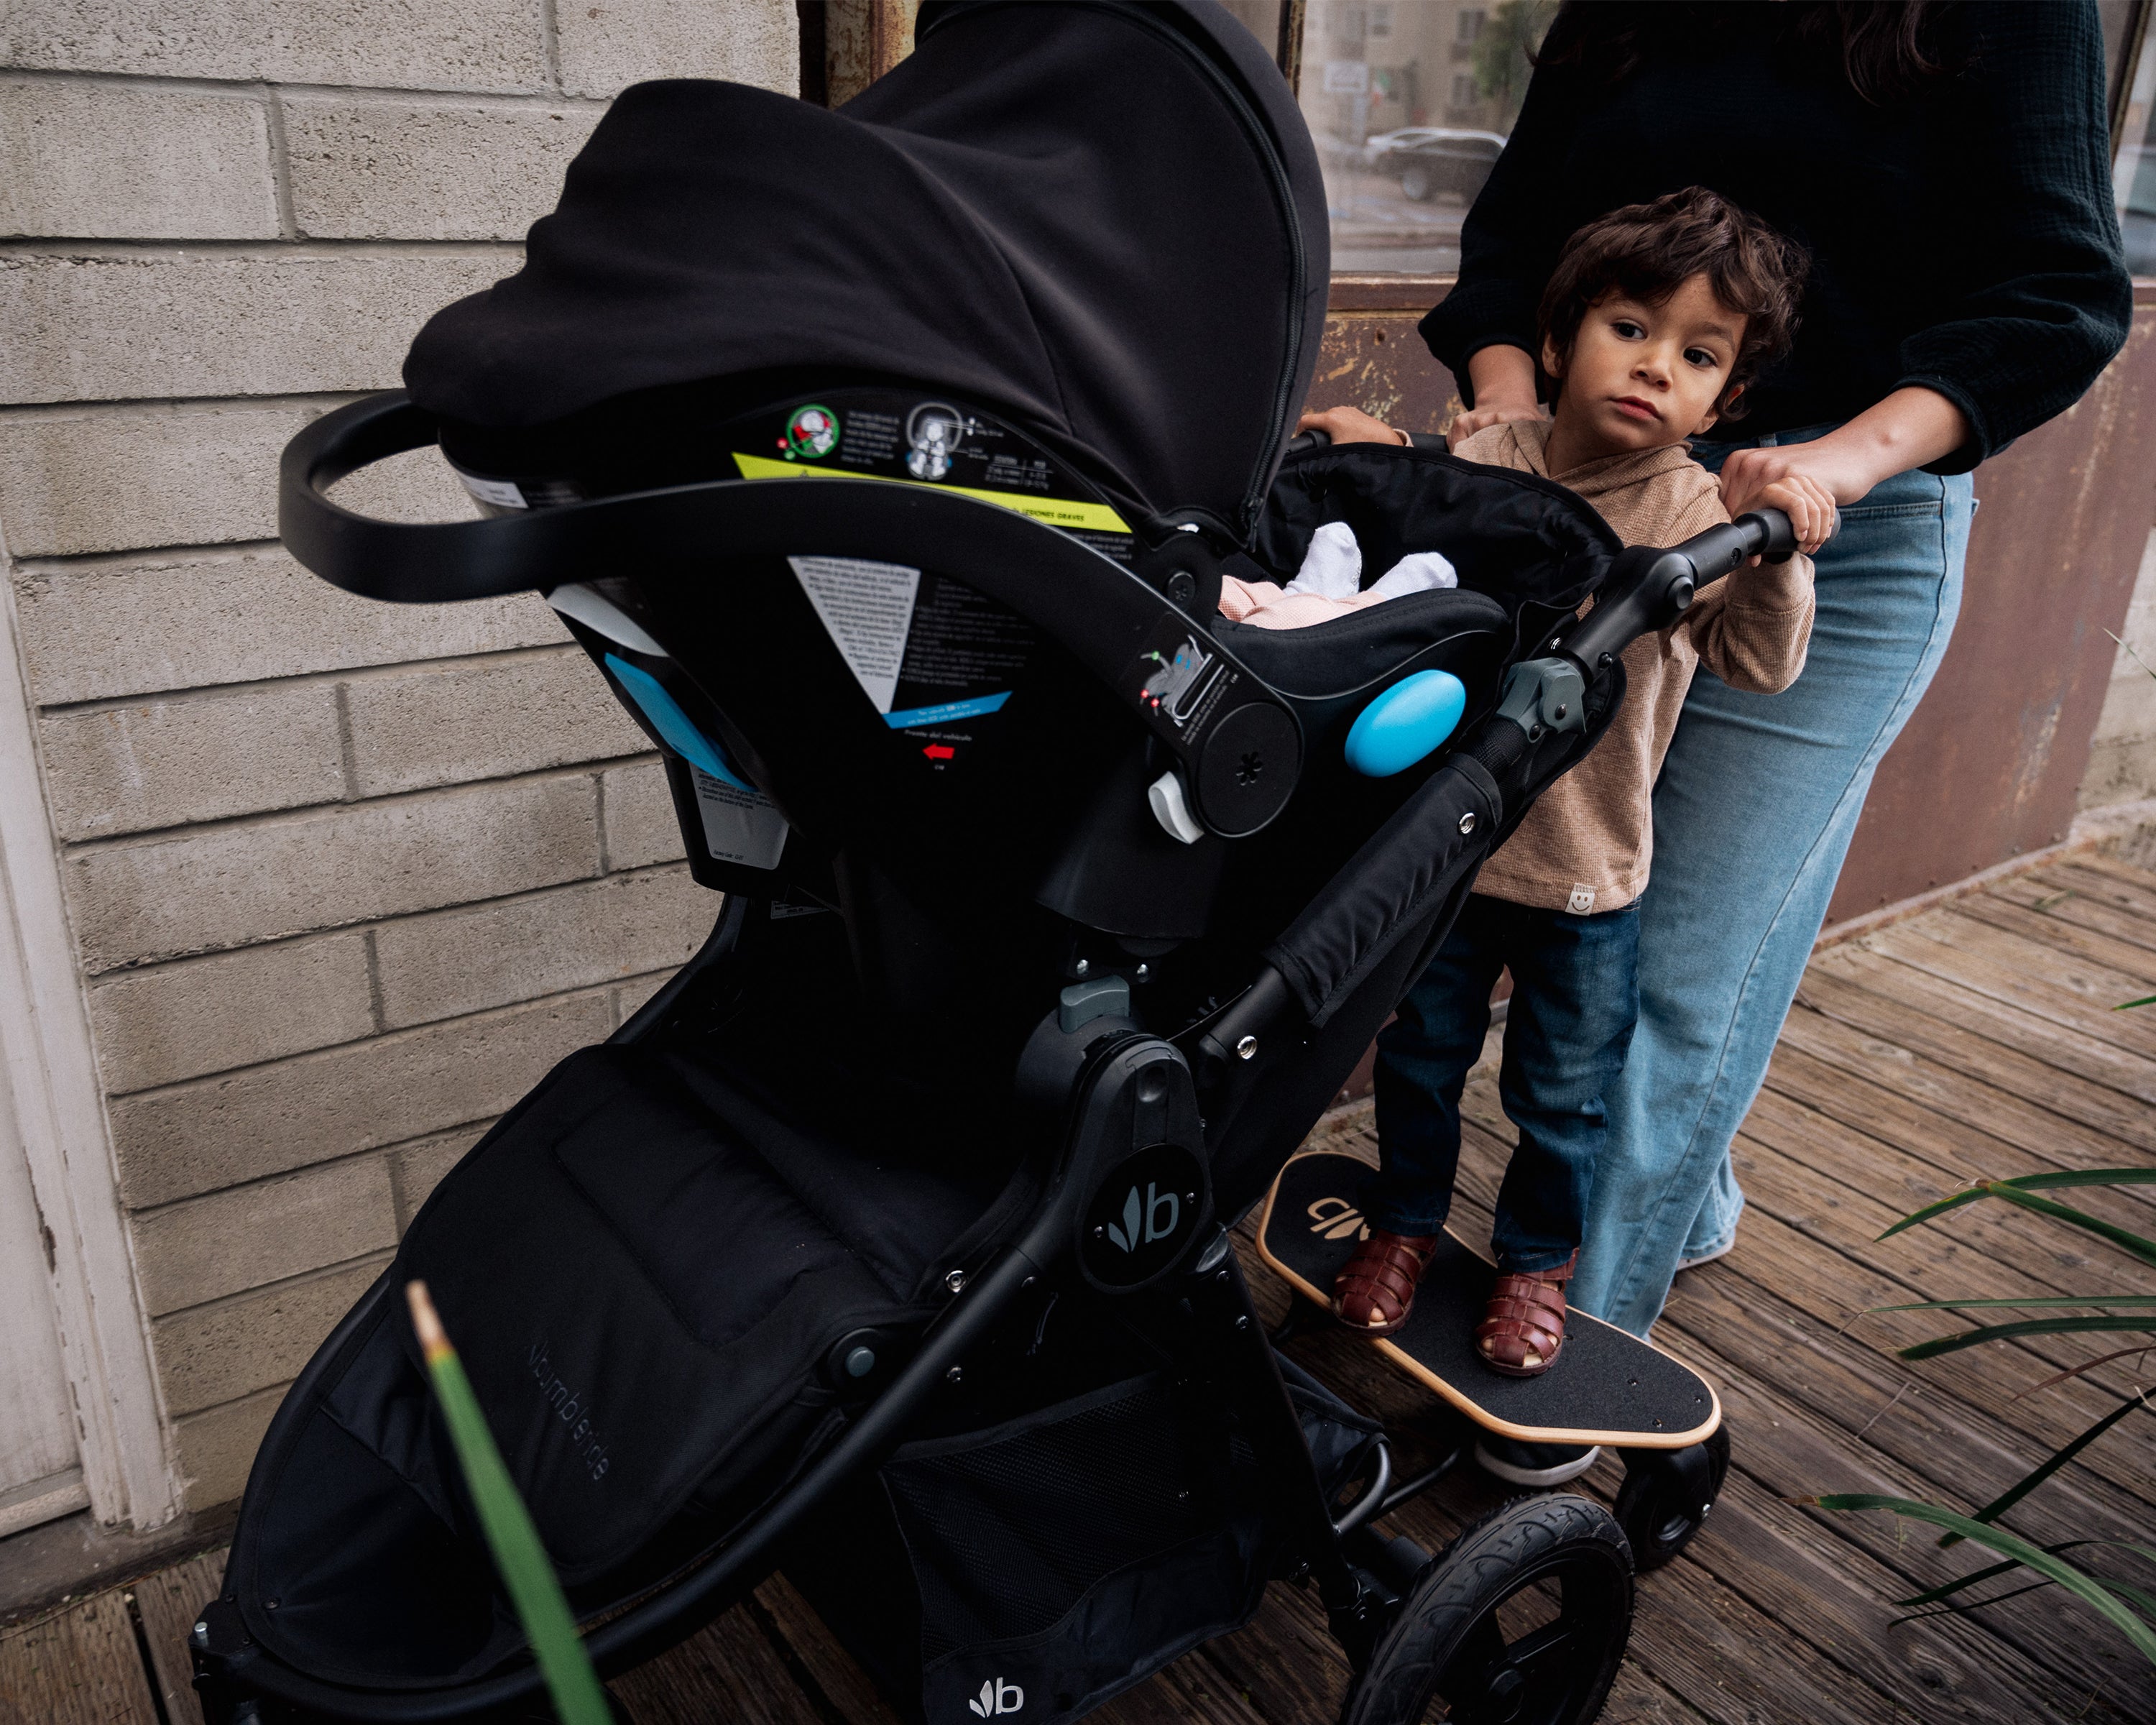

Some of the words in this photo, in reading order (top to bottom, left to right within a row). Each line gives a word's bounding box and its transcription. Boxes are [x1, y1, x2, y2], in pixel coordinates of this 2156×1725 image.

[1057, 512, 1084, 522] GRAVES
[1145, 1181, 1179, 1243] b
[995, 1676, 1024, 1715] b
